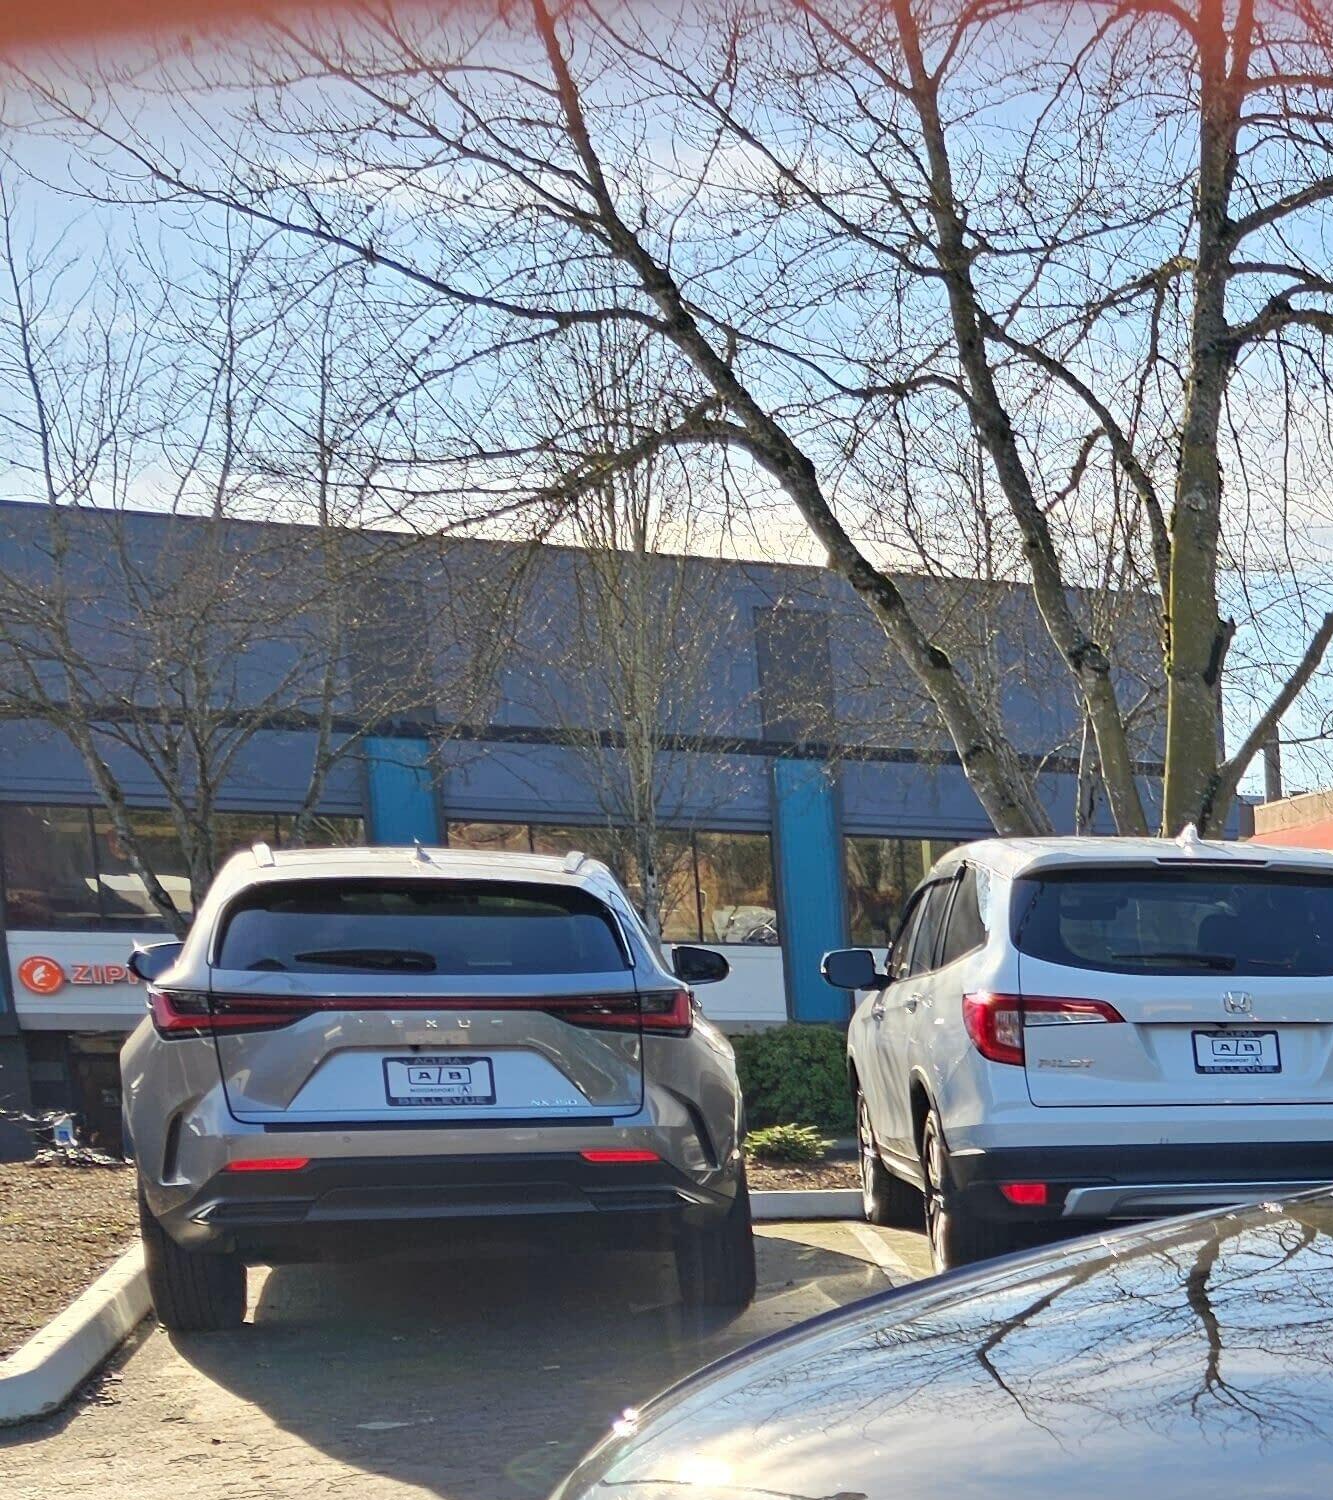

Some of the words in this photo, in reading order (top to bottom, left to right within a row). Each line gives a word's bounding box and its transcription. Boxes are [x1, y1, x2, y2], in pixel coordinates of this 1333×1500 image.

[357, 1018, 504, 1029] EXU
[1219, 1043, 1231, 1052] A
[1243, 1043, 1255, 1052] B
[413, 1056, 463, 1066] ACURA
[417, 1071, 432, 1080] A
[448, 1071, 462, 1080] B
[398, 1096, 488, 1106] BELLEVUE
